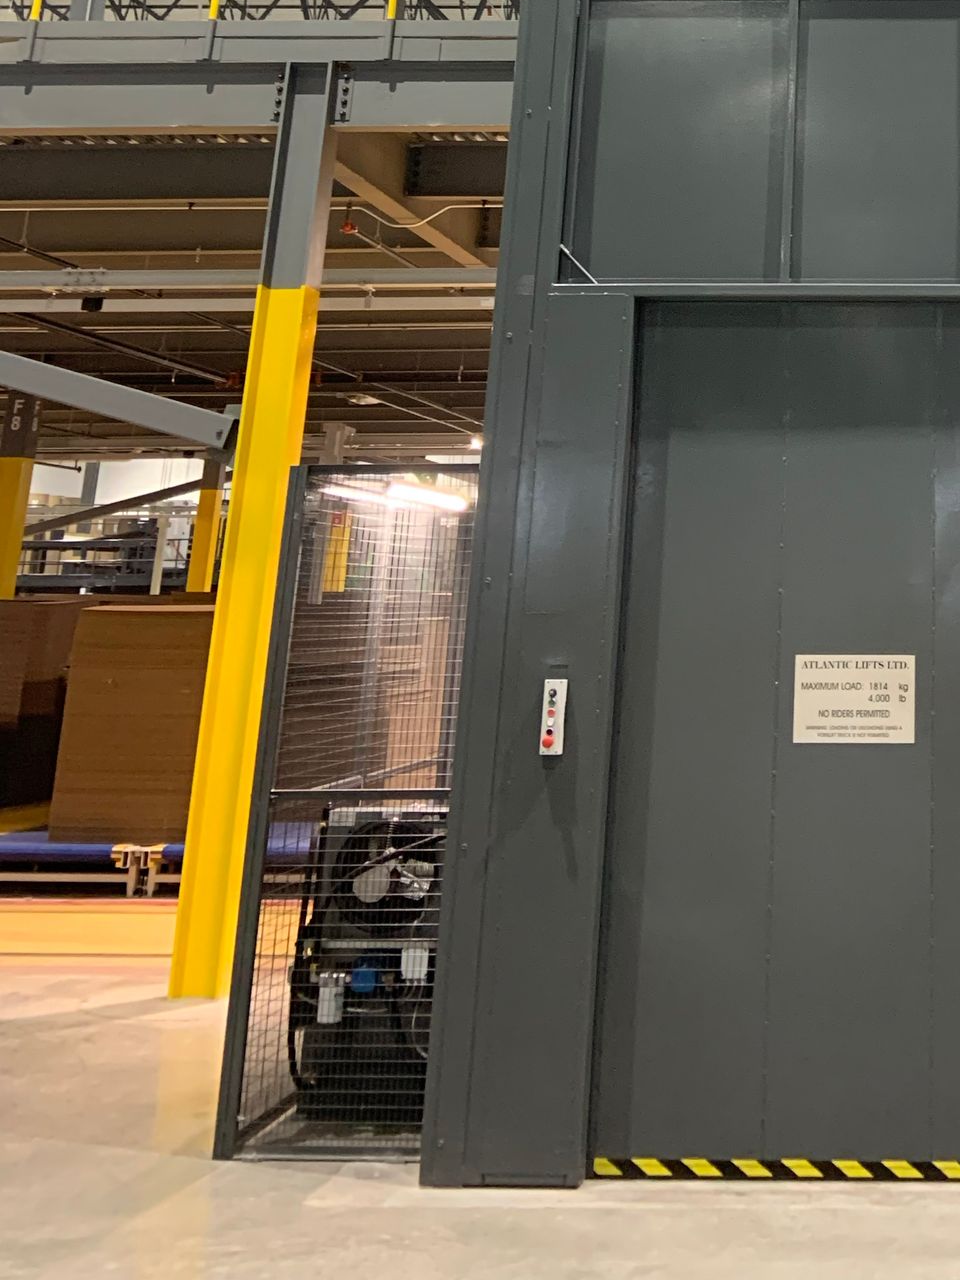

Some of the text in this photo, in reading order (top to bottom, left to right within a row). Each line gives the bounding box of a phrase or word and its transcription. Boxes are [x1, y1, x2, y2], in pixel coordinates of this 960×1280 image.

[13, 399, 25, 414] F
[11, 416, 21, 430] 8
[801, 660, 910, 670] ATLANTIC LIFTS LTD.
[800, 682, 839, 691] MAXIMUM
[869, 682, 888, 691] 1814
[898, 682, 909, 693] kg
[898, 694, 907, 703] lb
[818, 709, 891, 718] NO RIDERS PERMITTED
